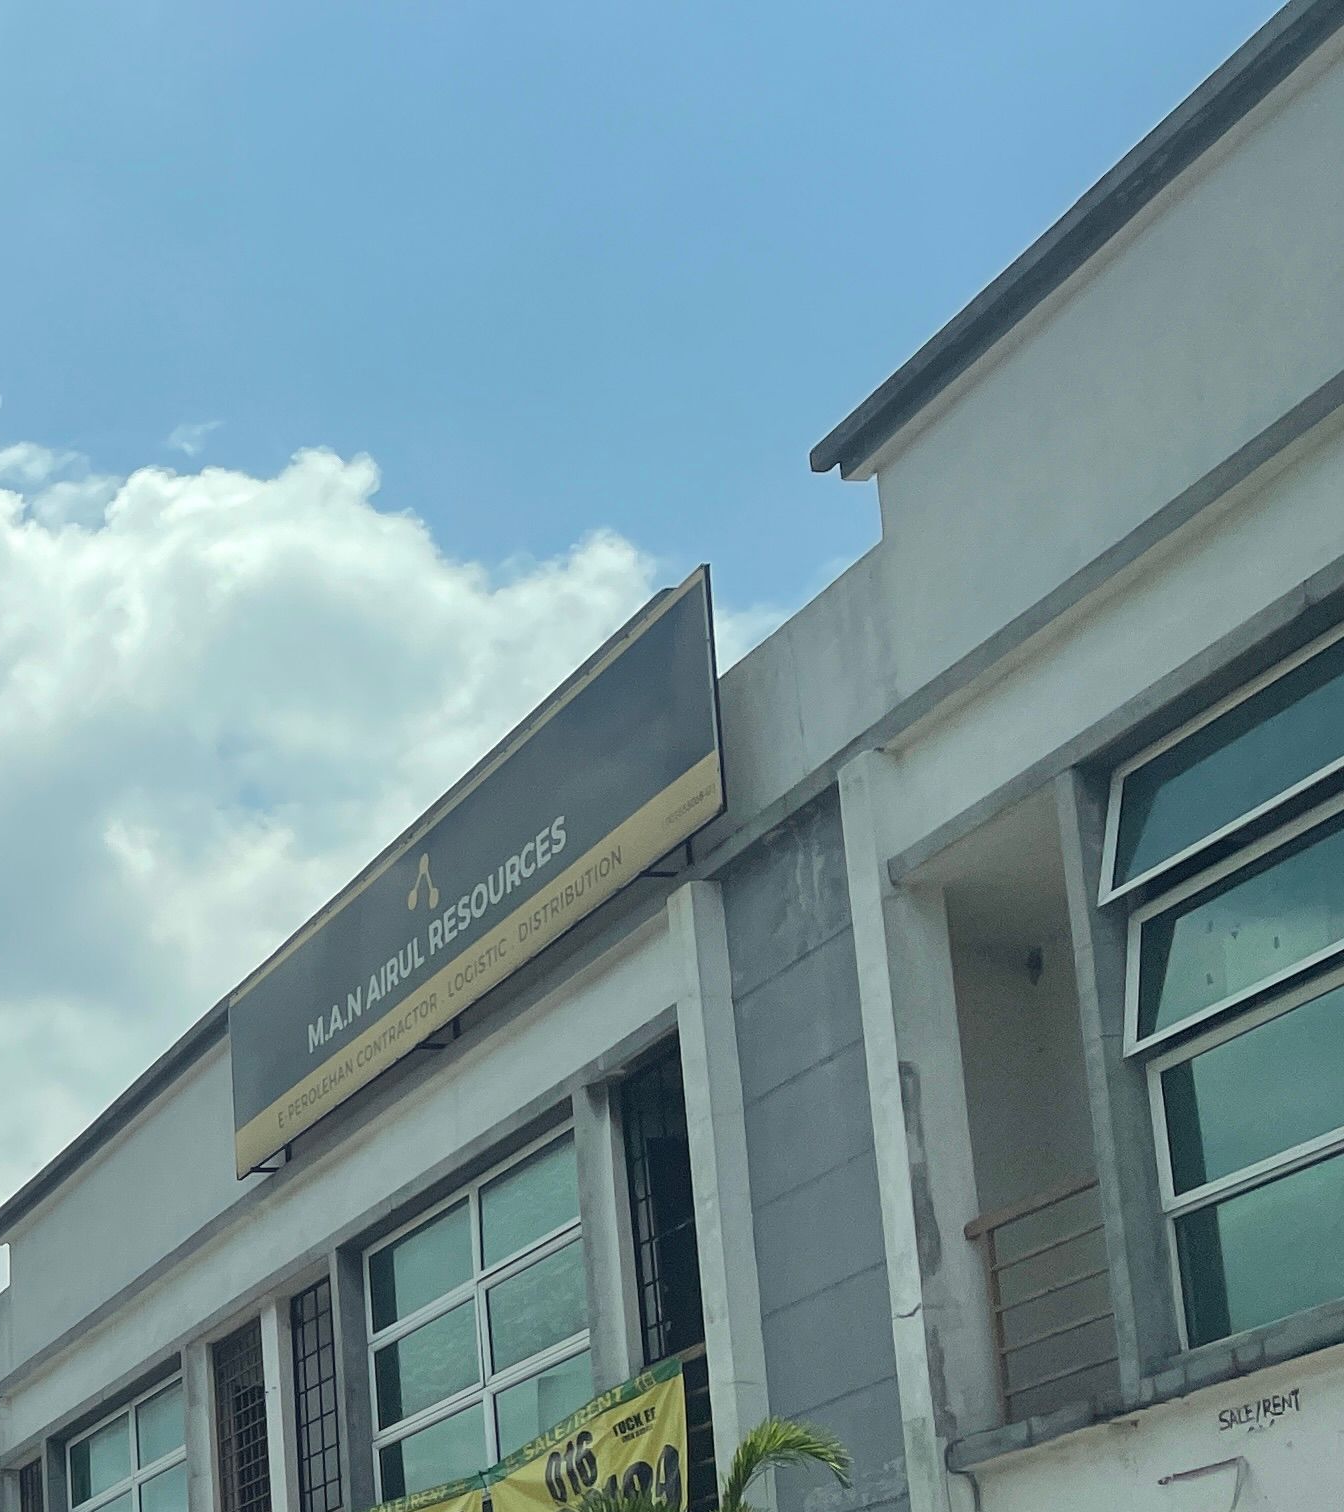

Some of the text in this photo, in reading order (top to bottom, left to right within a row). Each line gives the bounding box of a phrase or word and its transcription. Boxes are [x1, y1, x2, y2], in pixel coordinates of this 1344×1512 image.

[307, 814, 568, 1055] M.A.N AIRUL RESOURCES
[355, 992, 438, 1068] CONTRACTOR
[446, 938, 508, 998] LOGISTIC
[517, 845, 624, 944] DISTRIBUTION
[545, 1430, 599, 1504] 016
[1218, 1387, 1300, 1431] SALE/RENT
